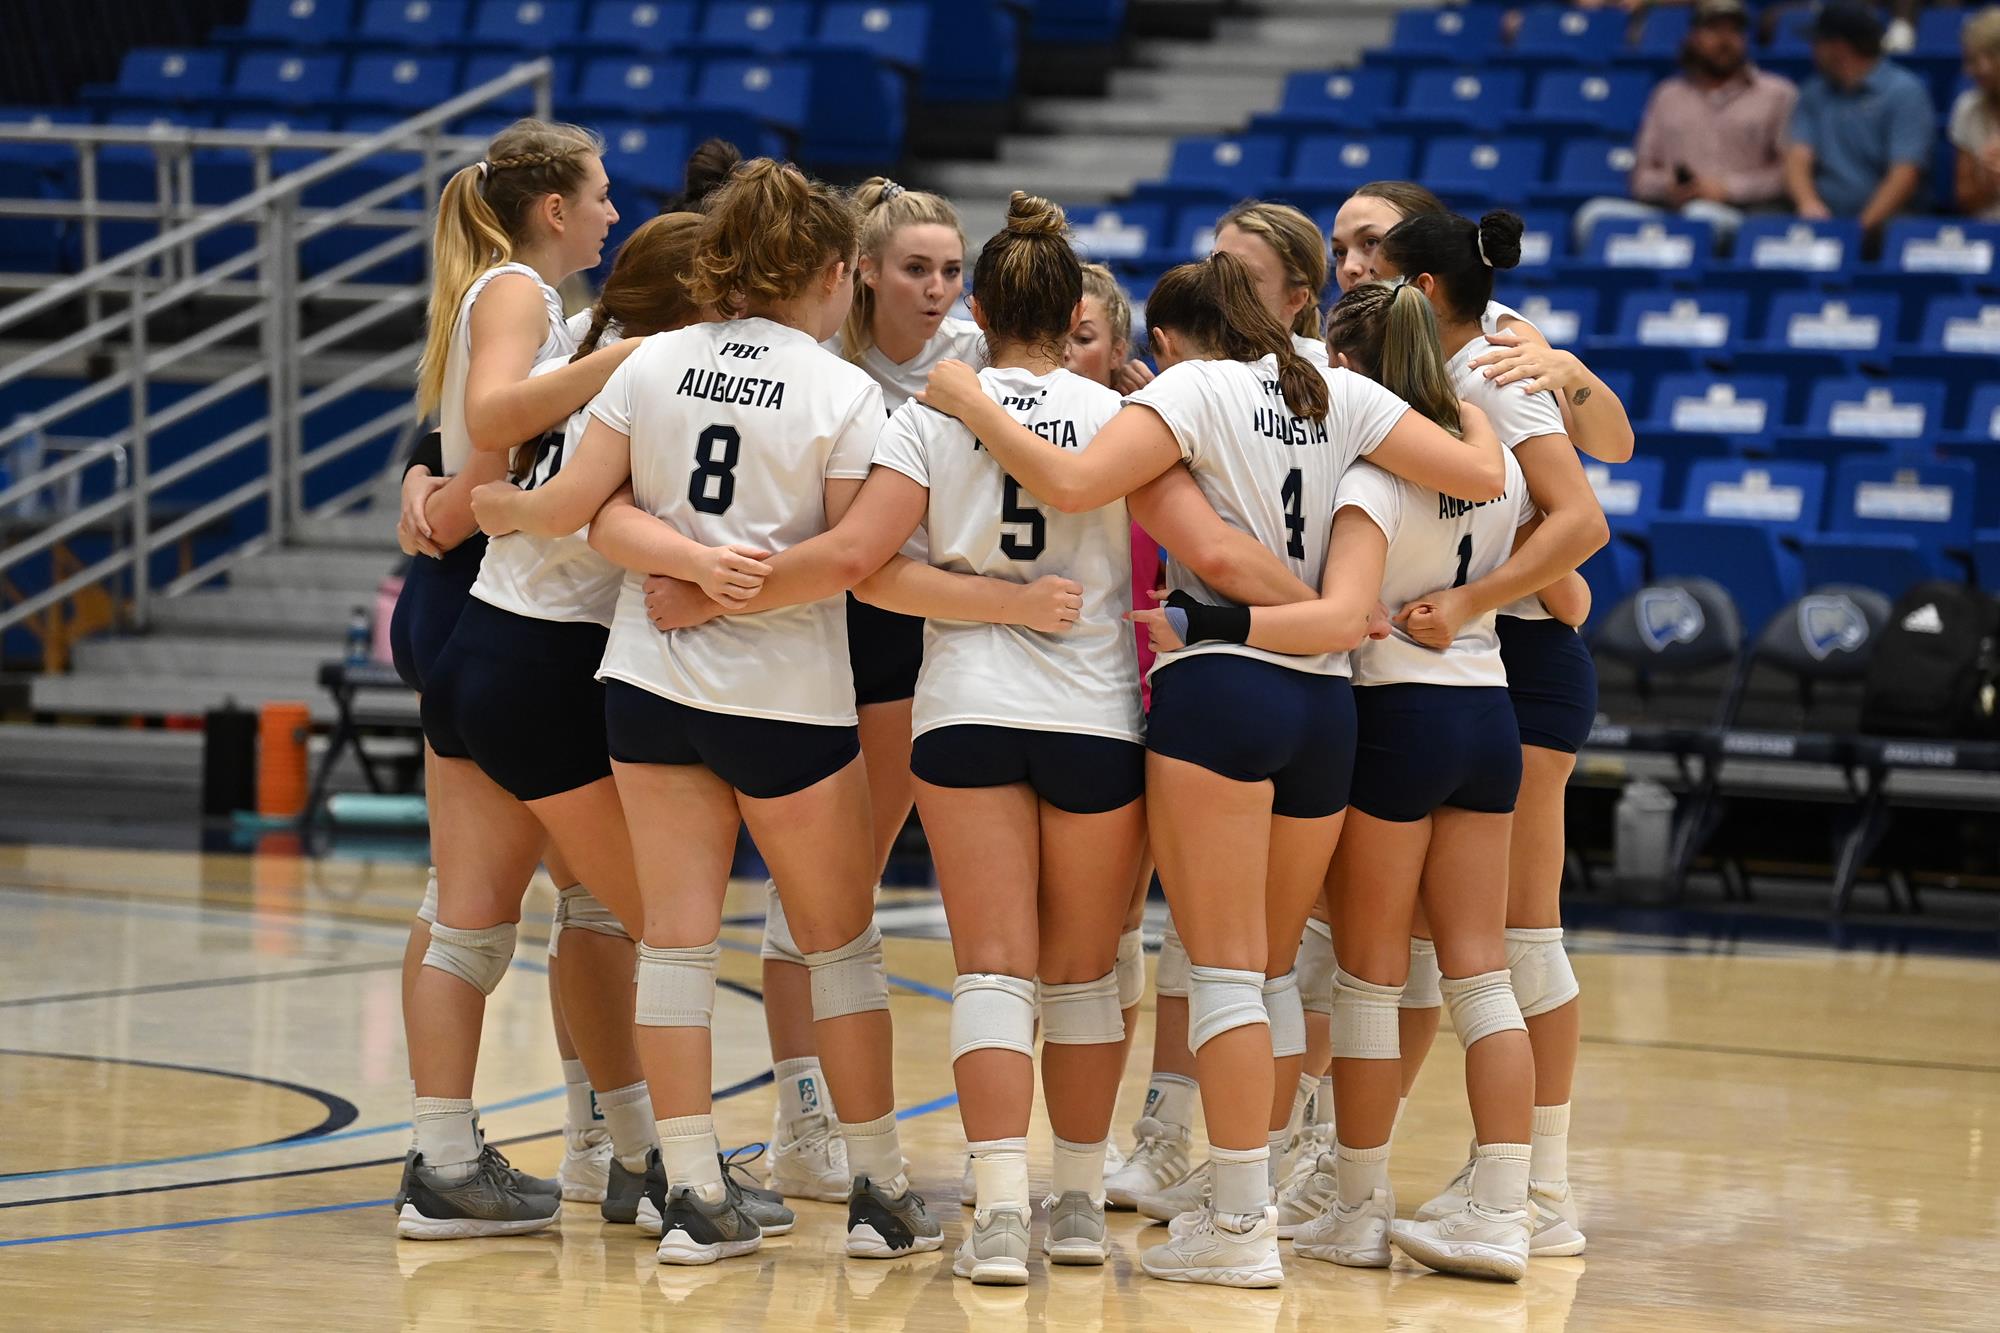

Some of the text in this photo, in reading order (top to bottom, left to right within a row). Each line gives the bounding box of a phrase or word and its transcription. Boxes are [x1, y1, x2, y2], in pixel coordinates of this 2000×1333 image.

[719, 342, 770, 360] PBC
[676, 367, 786, 410] AUGUSTA
[687, 423, 742, 516] 8
[1000, 473, 1047, 561] 5
[1281, 467, 1305, 560] 4
[1453, 533, 1473, 588] 1
